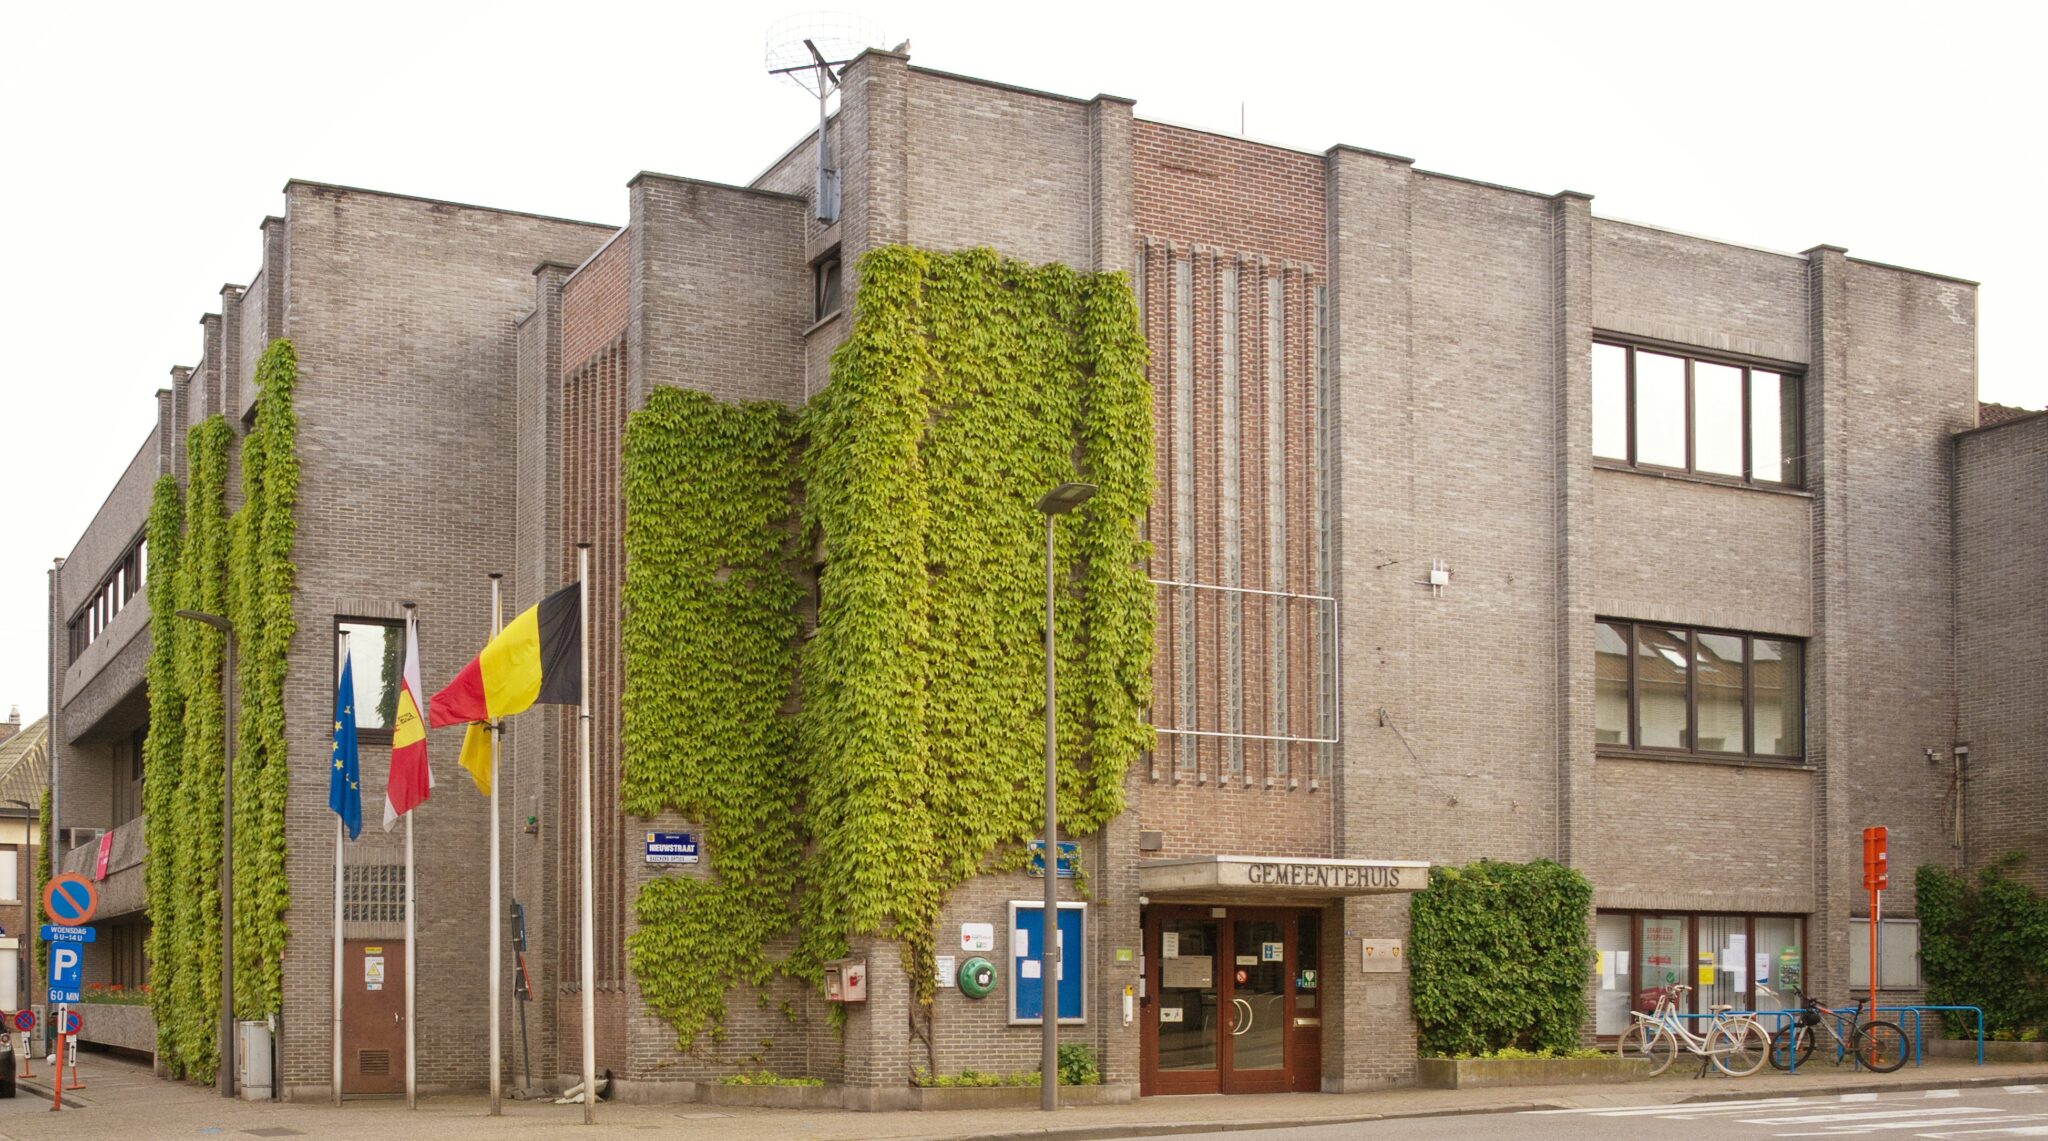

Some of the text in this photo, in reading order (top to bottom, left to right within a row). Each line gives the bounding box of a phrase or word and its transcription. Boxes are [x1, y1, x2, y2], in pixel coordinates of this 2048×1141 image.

[649, 844, 695, 852] NIEUWSTRAAT
[1248, 864, 1400, 887] GEMEENTEHUIS
[51, 926, 87, 935] WOENSDAG
[54, 949, 78, 981] P
[50, 990, 80, 1002] 60 MIN
